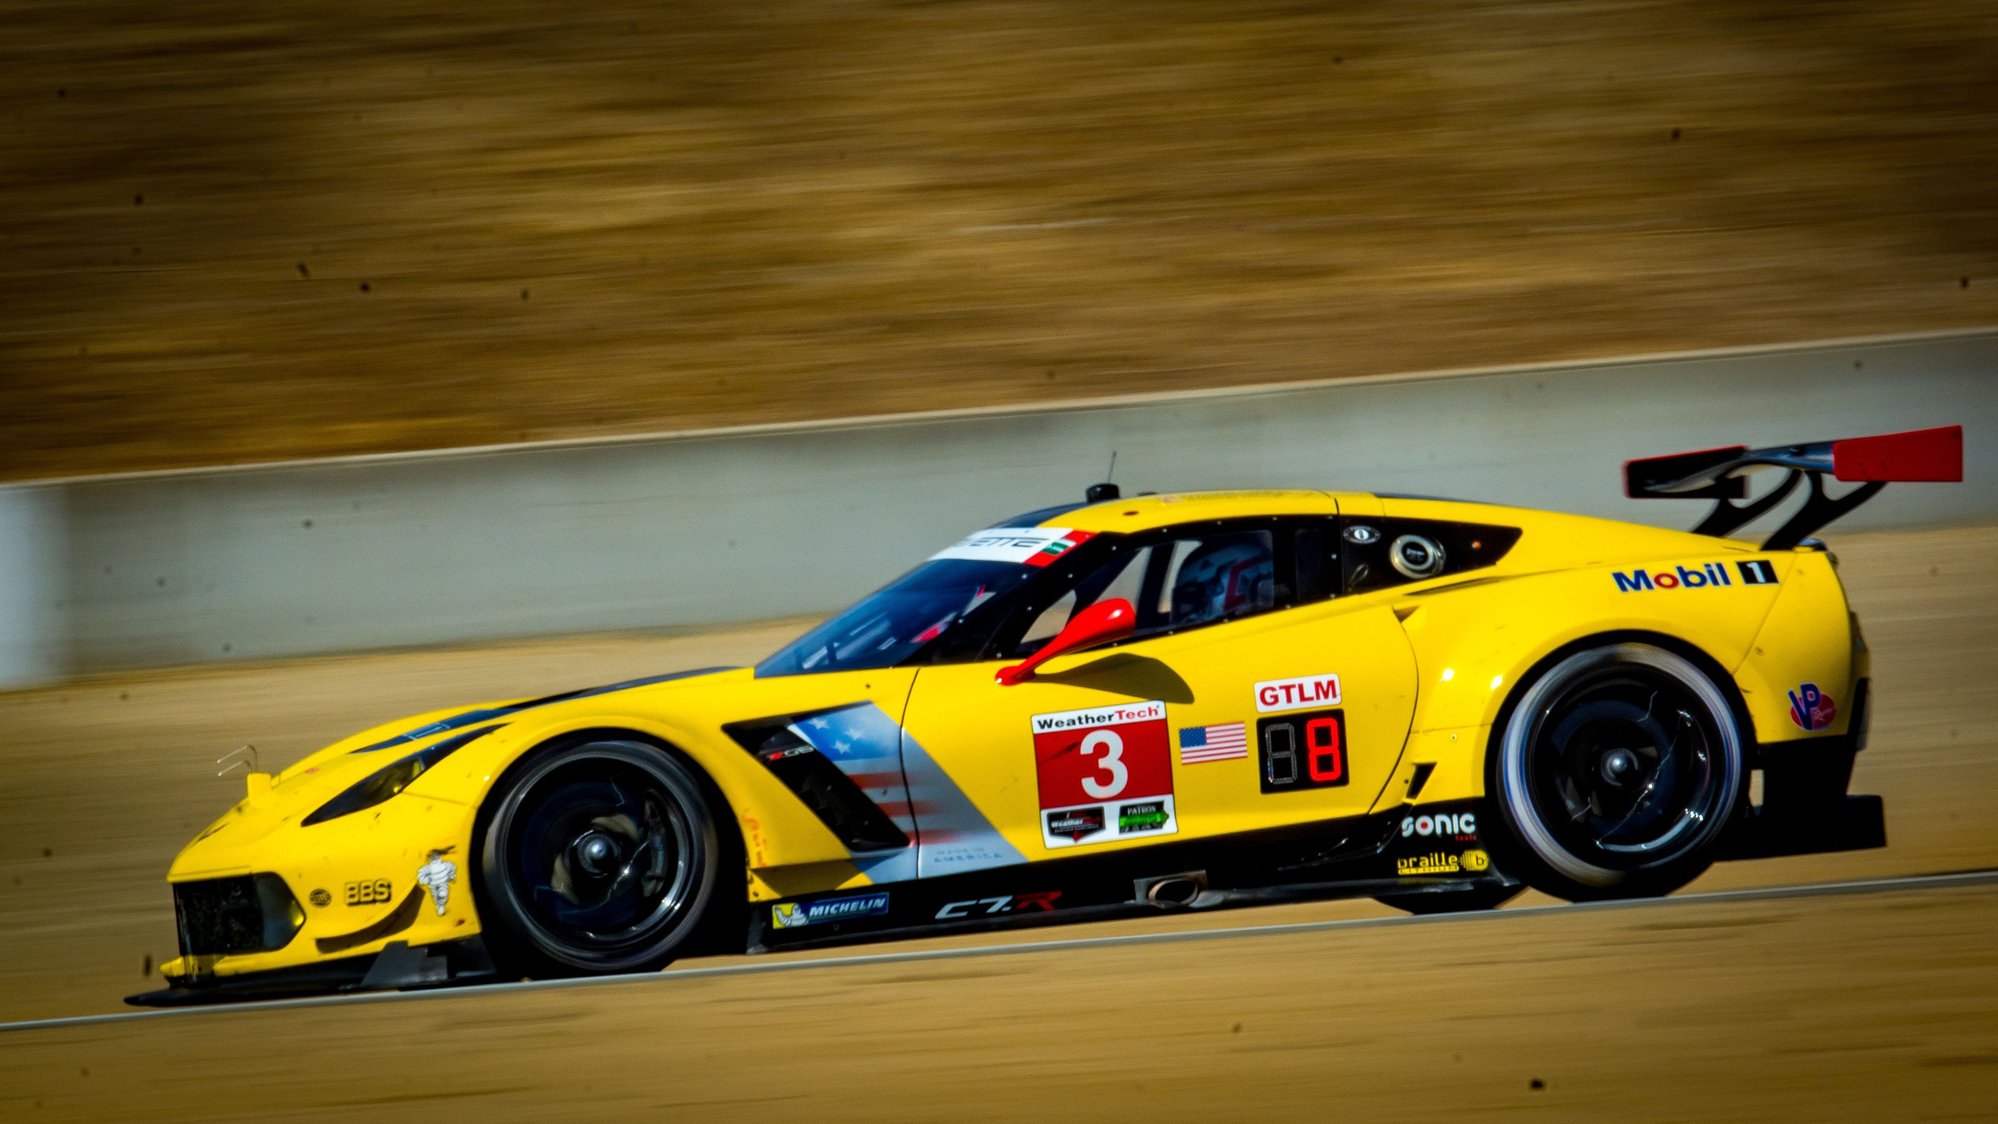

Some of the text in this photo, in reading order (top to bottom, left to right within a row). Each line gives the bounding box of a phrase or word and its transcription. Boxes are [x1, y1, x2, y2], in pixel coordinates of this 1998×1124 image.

[968, 536, 1050, 549] ETTE
[1611, 561, 1767, 593] Mobil 1
[1258, 679, 1338, 707] GTLM
[1787, 682, 1821, 731] VP
[1037, 705, 1159, 730] WeatherTech
[1079, 729, 1129, 799] 3
[344, 878, 392, 907] BBS
[808, 897, 886, 917] MICHELIN
